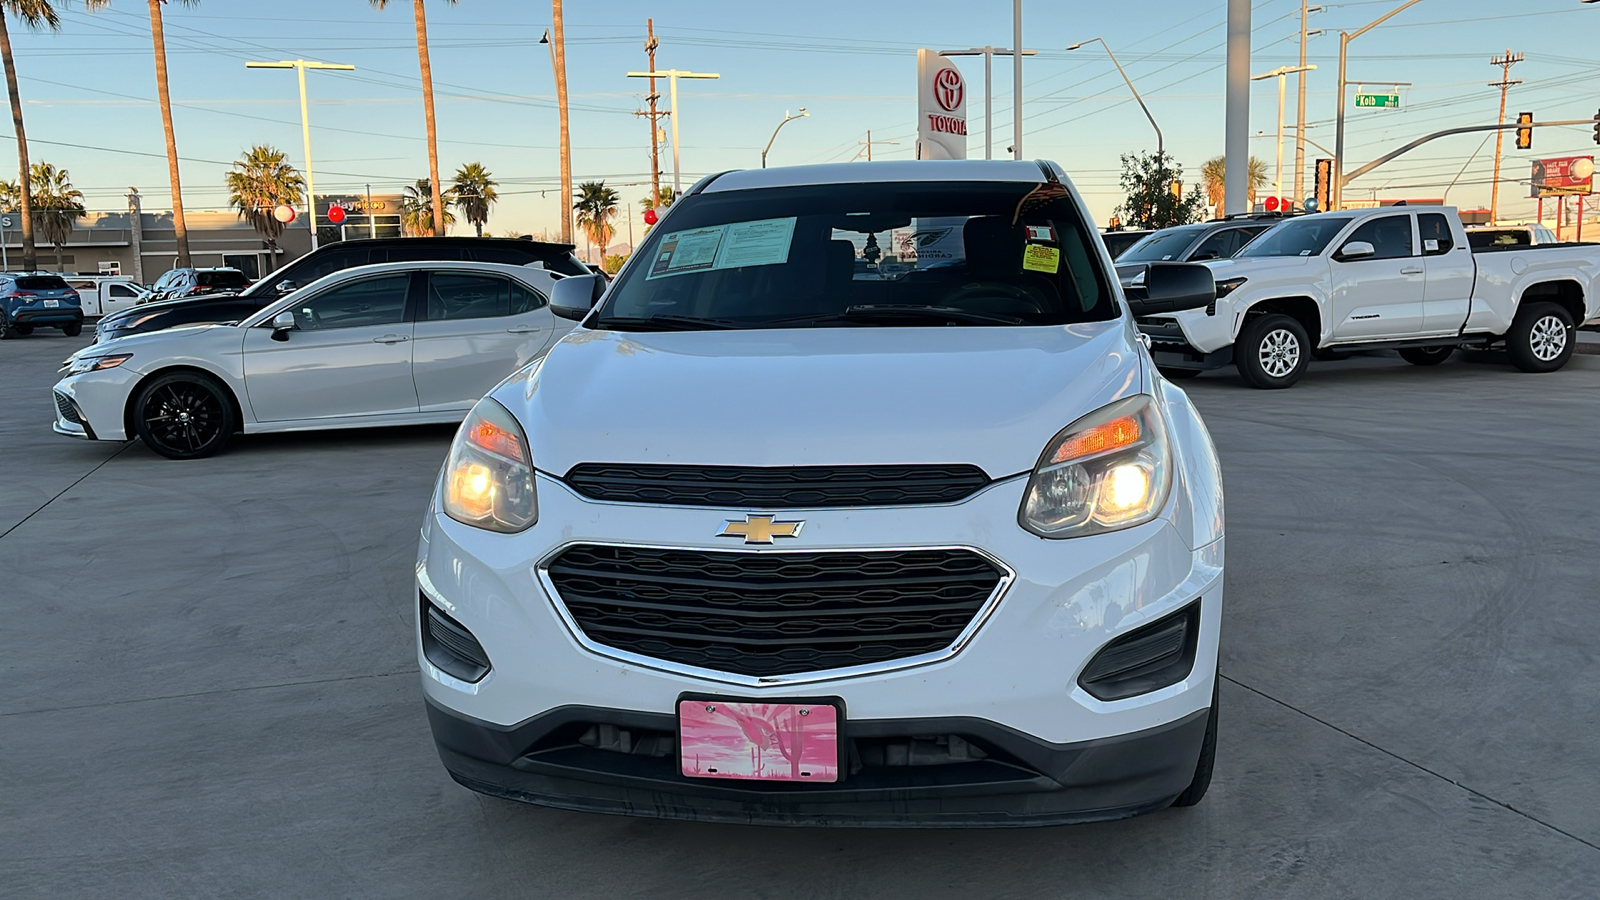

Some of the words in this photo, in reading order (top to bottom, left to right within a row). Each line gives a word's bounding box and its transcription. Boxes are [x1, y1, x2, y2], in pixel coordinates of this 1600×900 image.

[1360, 95, 1376, 106] Kolb
[928, 114, 967, 136] TOYOTA
[2, 217, 12, 227] S
